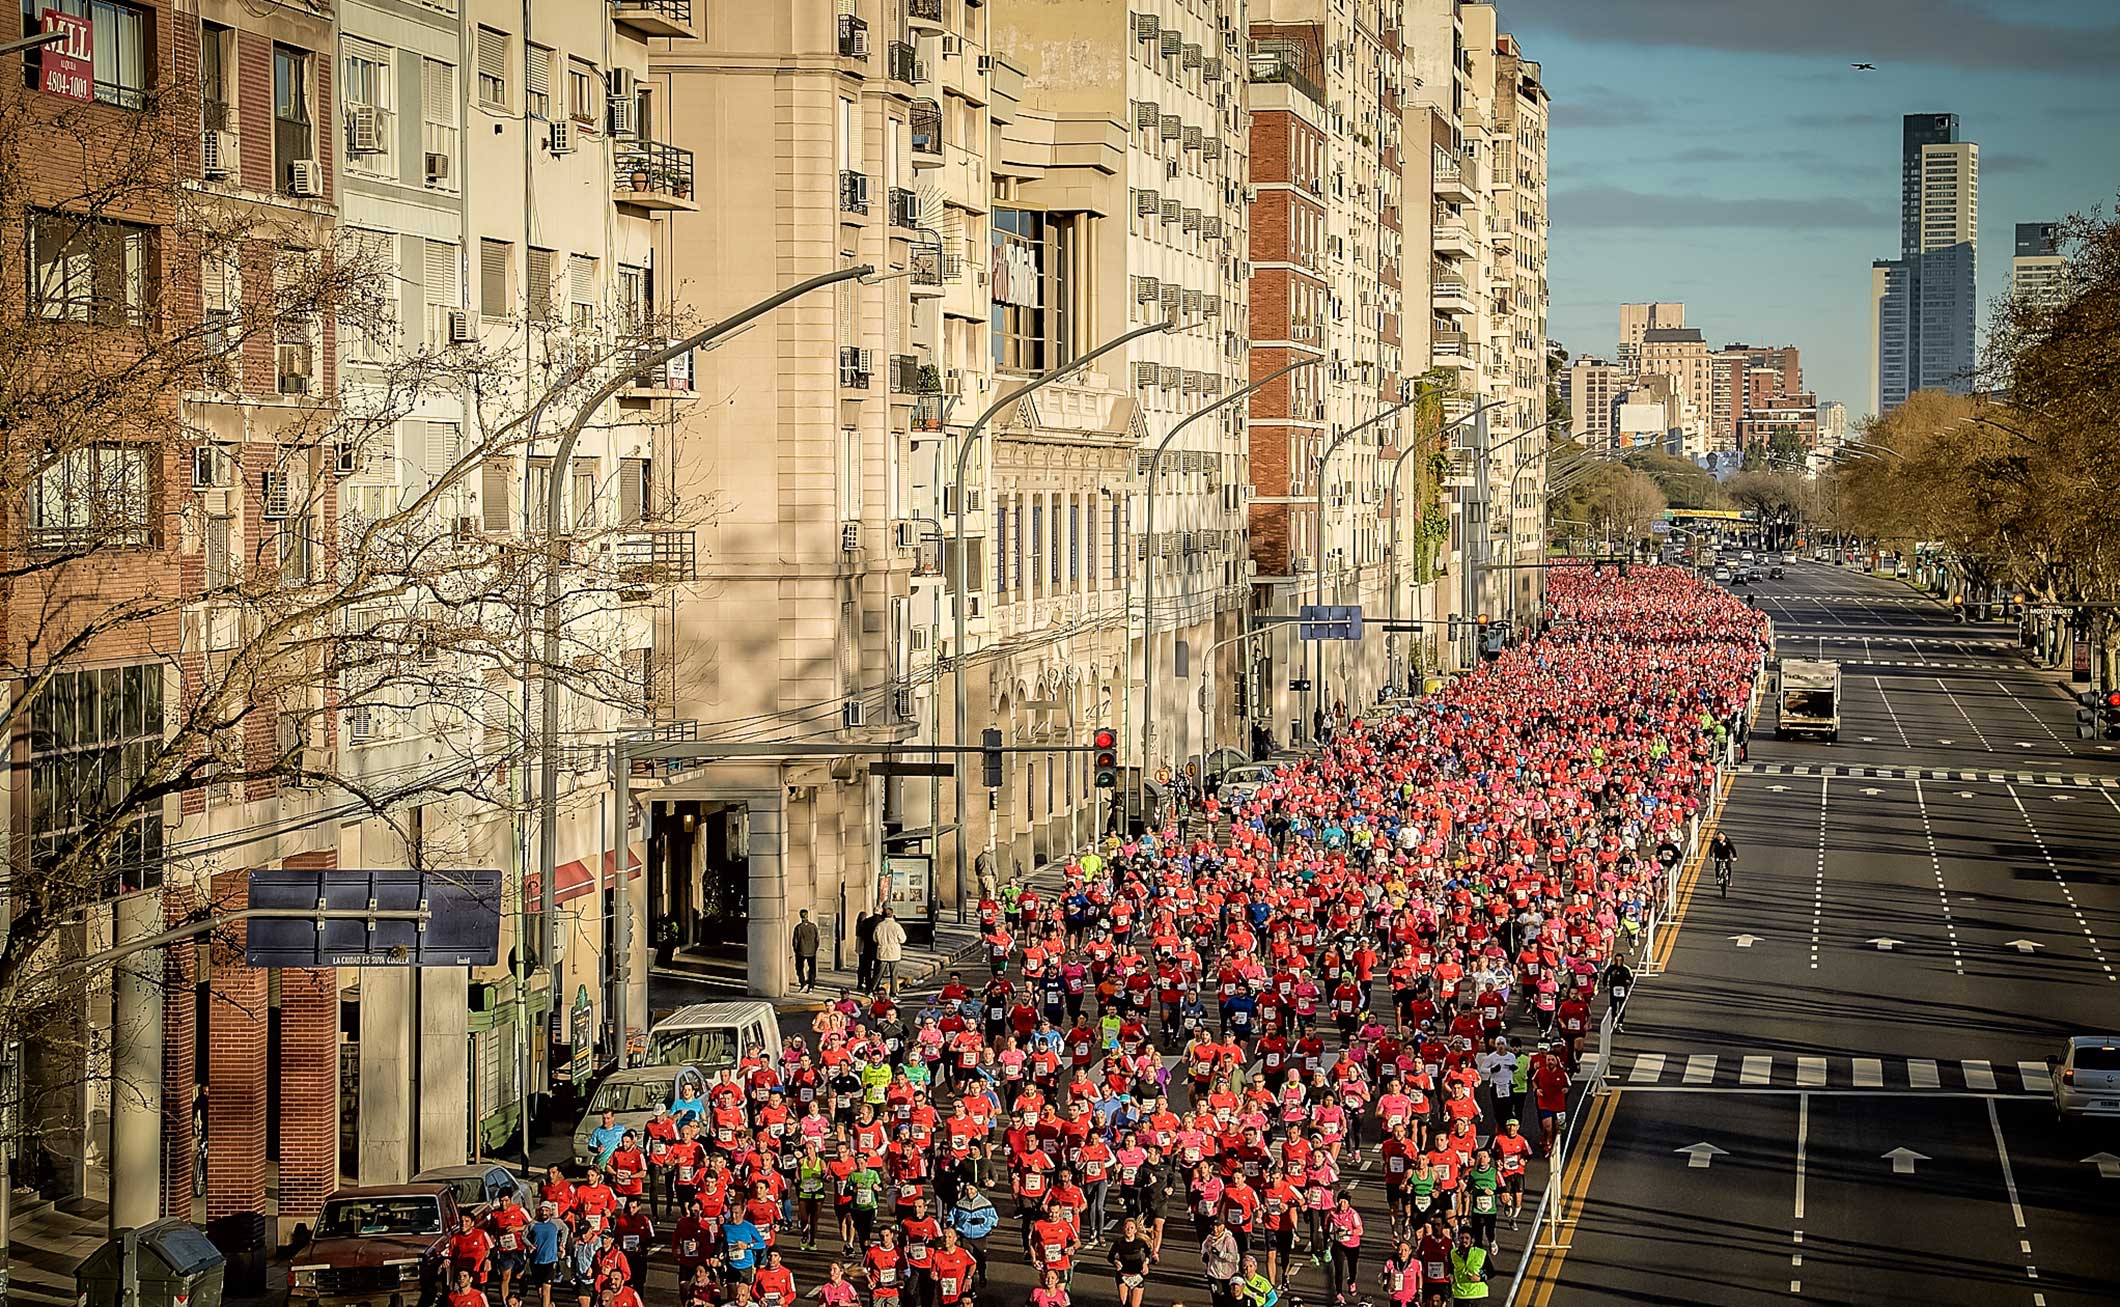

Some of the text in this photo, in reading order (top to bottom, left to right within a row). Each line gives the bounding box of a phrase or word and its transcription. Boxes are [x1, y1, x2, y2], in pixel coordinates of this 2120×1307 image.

[44, 16, 91, 62] MLL
[46, 70, 88, 99] 4804-1001
[332, 956, 341, 965] LA
[341, 956, 361, 965] CIUDAD
[362, 956, 370, 965] ES
